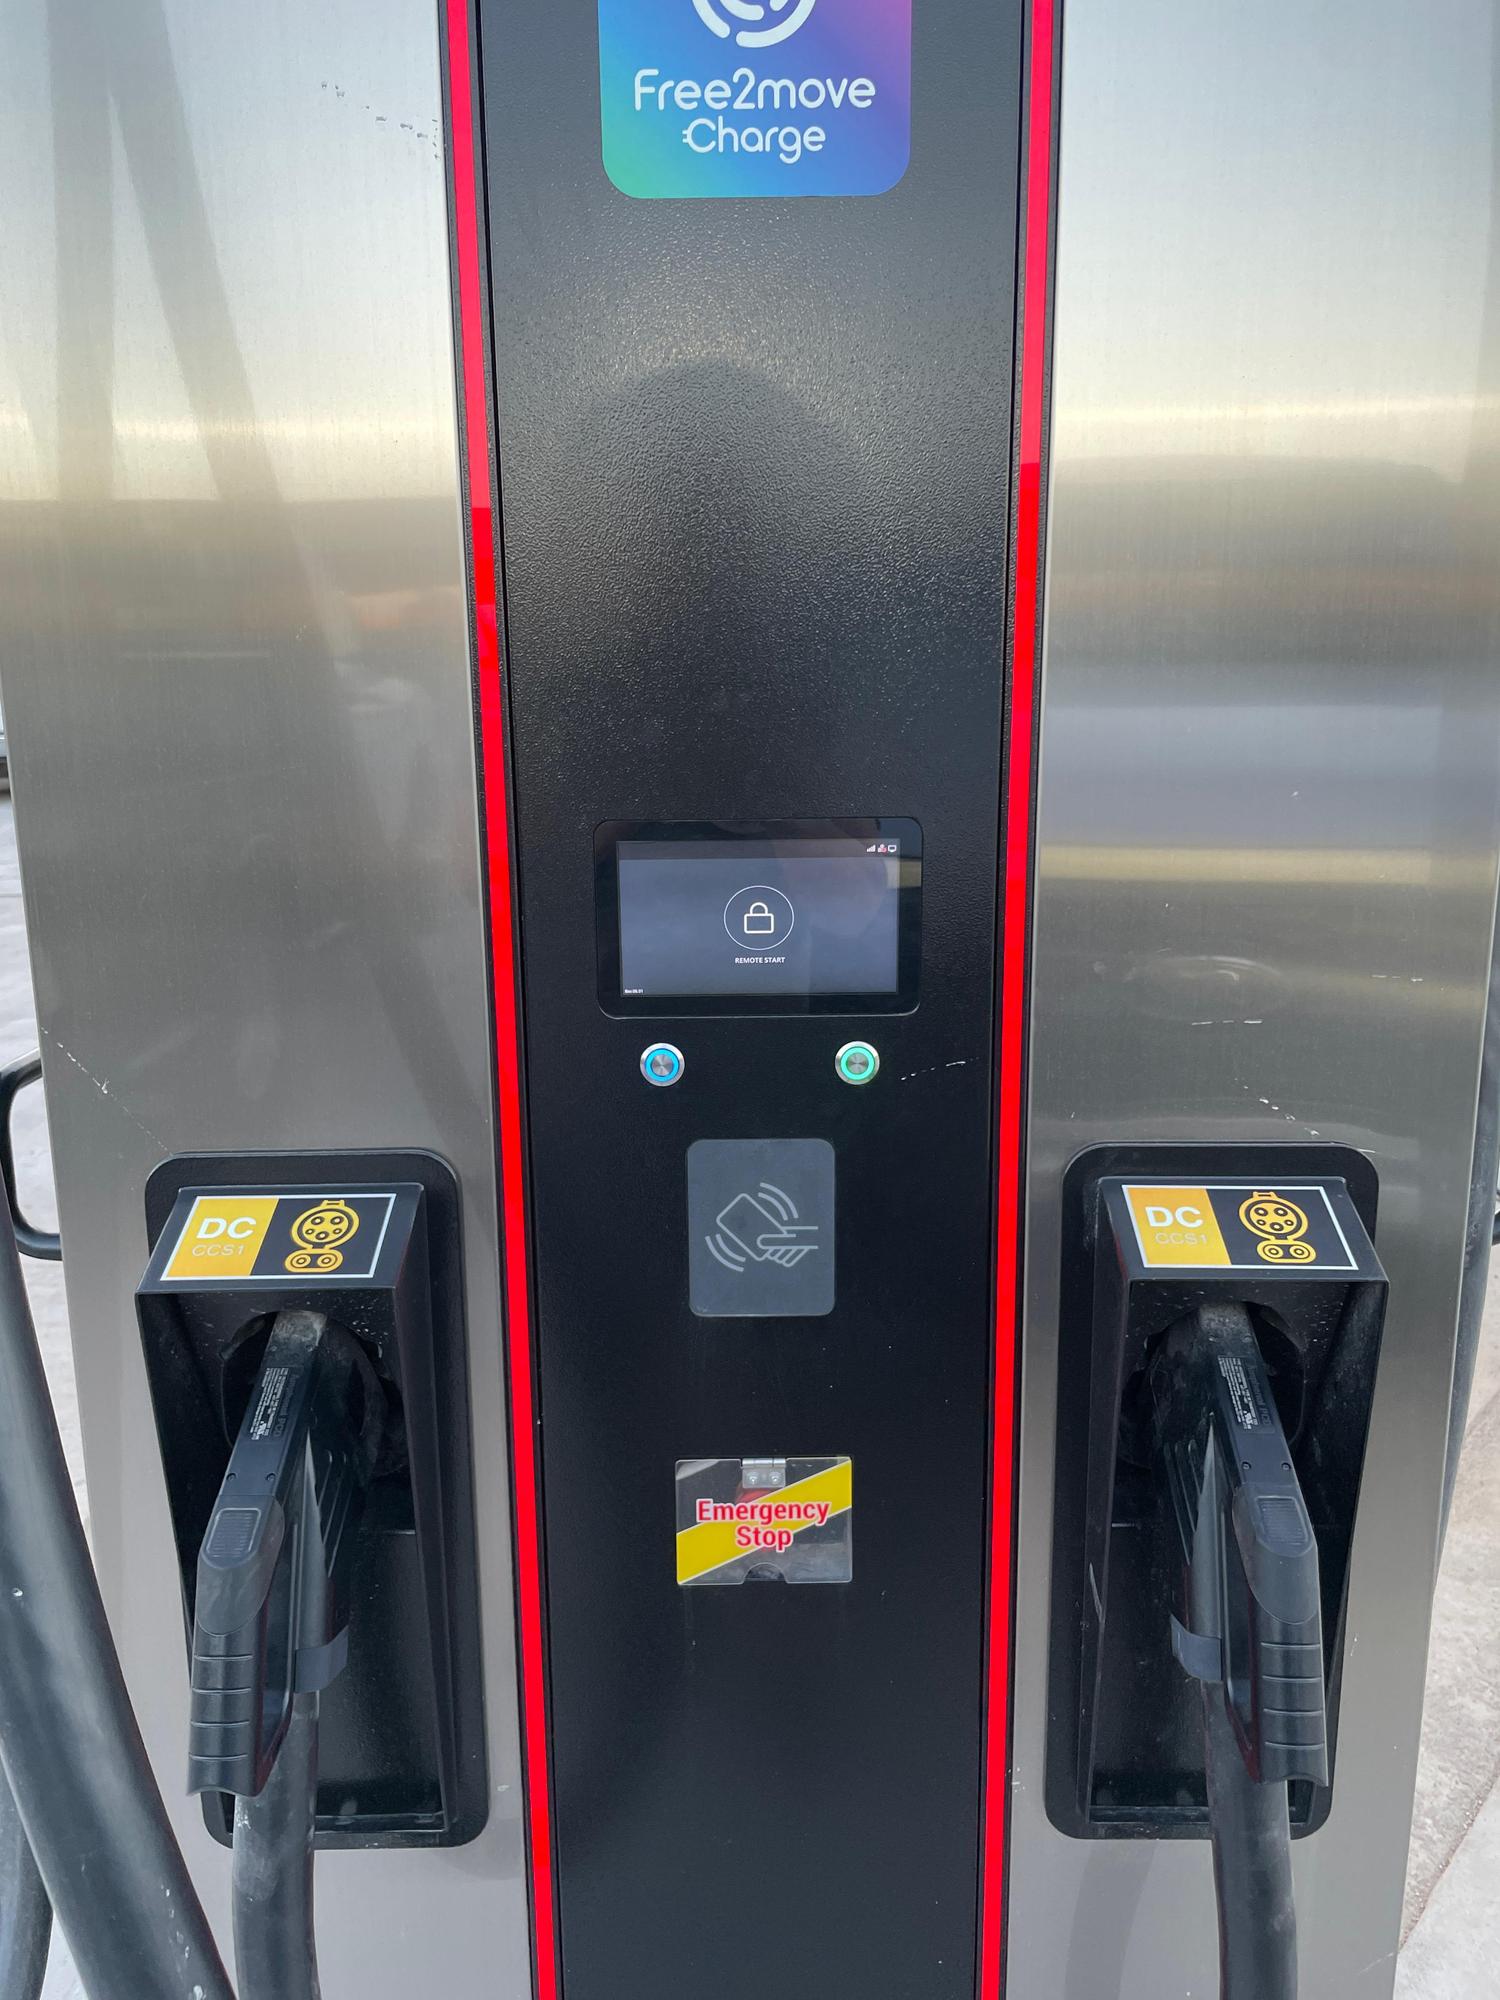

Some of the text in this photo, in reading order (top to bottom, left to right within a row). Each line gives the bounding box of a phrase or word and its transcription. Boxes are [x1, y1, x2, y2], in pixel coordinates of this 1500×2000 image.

[634, 67, 876, 110] Free2move
[683, 115, 826, 164] Charge
[196, 1217, 257, 1239] DC
[1144, 1206, 1204, 1228] DC
[1155, 1232, 1208, 1245] CCS1
[191, 1244, 245, 1257] CCS1
[697, 1499, 830, 1525] Emergency
[736, 1526, 793, 1551] Stop
